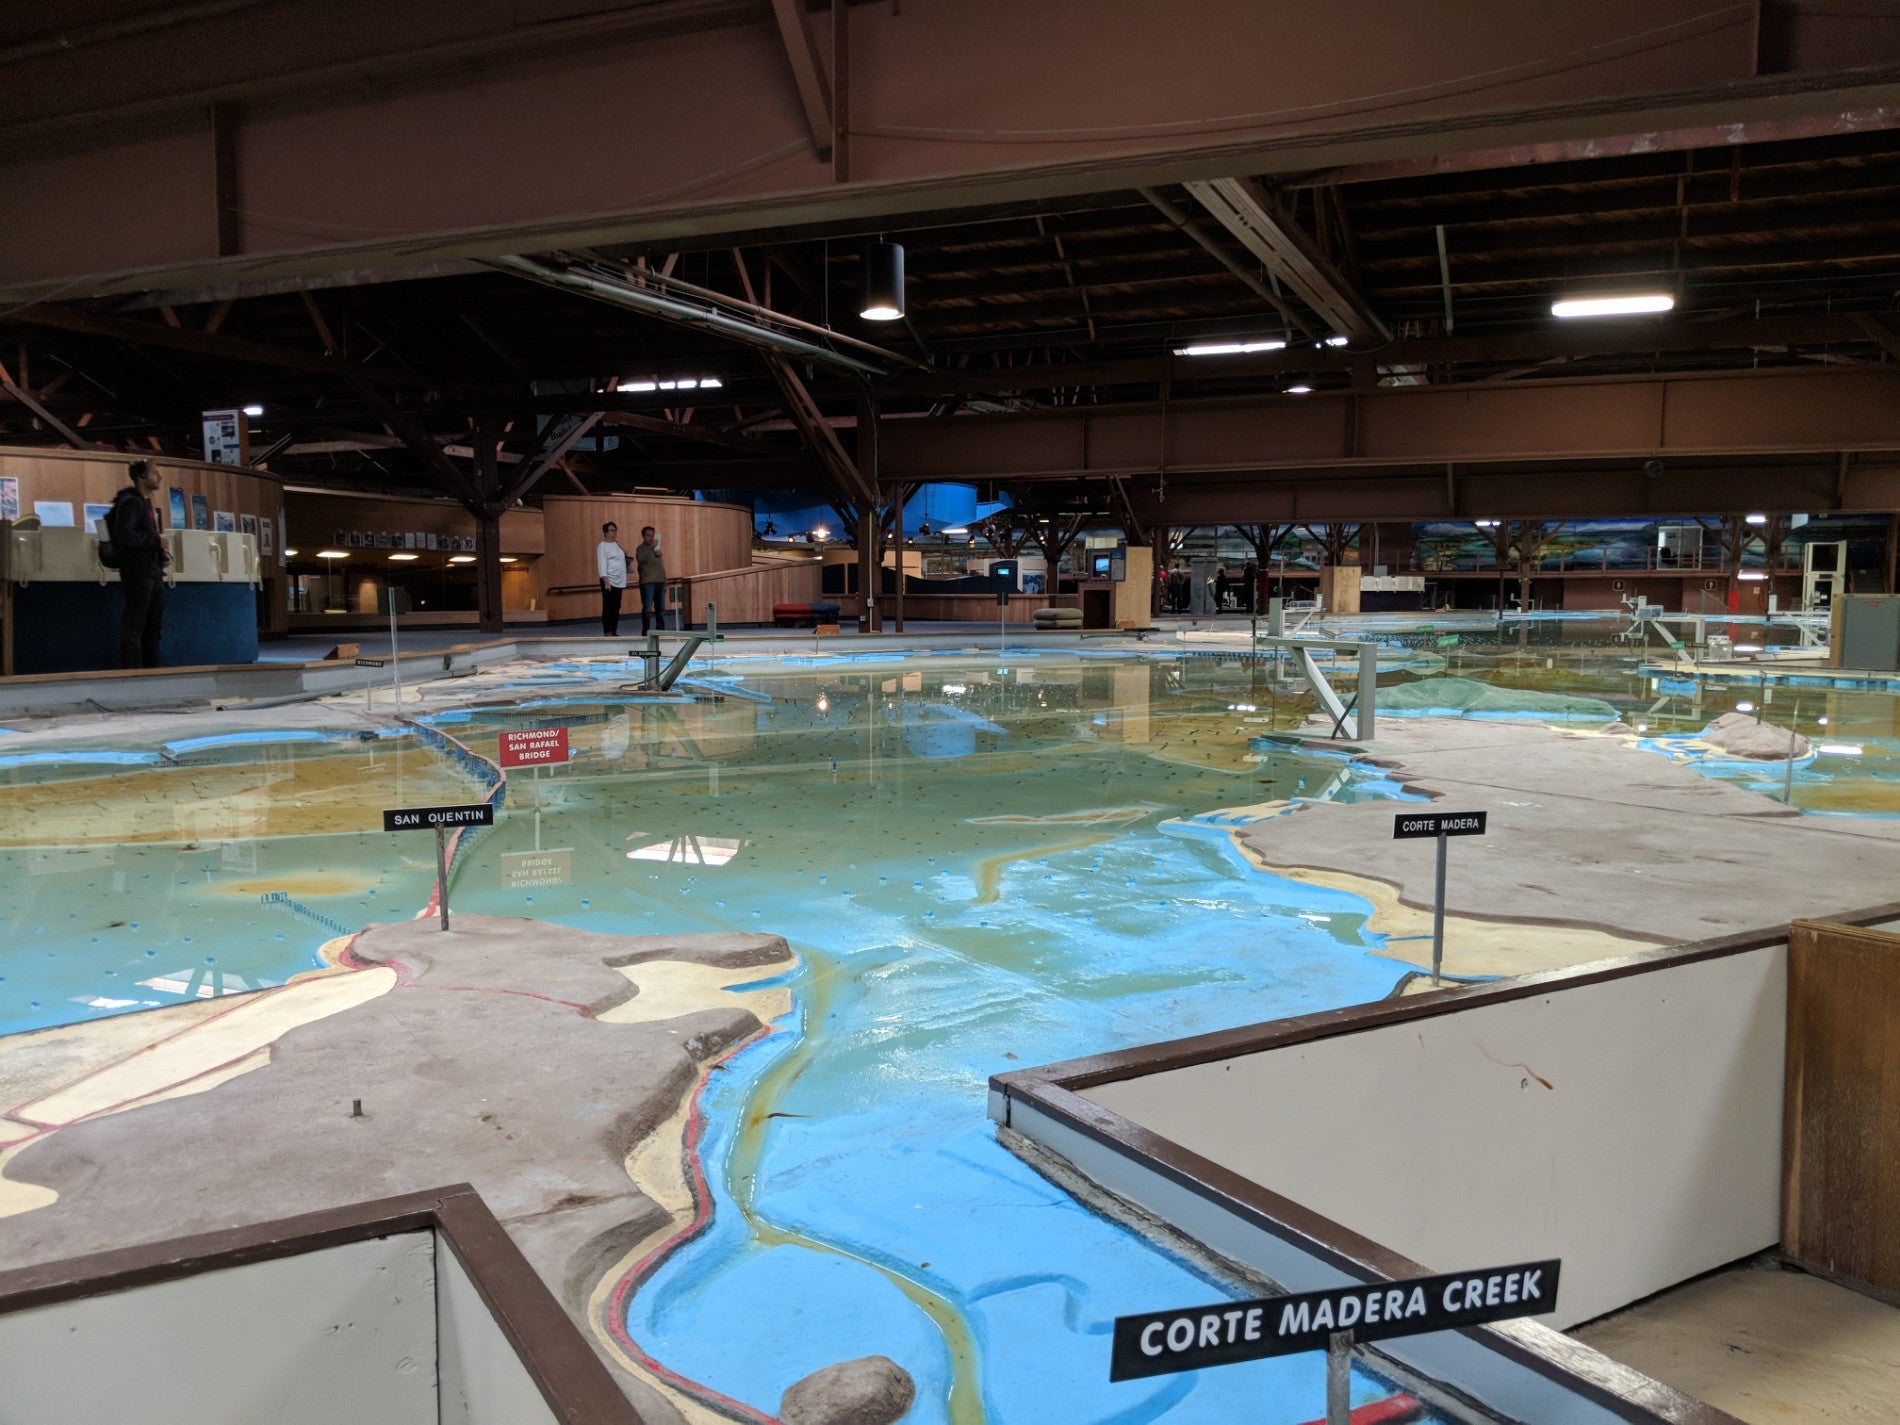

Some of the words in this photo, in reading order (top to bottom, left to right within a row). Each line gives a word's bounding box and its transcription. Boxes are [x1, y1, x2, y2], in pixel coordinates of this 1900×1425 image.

[508, 729, 560, 741] RICHMOND/
[509, 743, 527, 751] SAN
[530, 740, 560, 749] RAFAEL
[519, 750, 550, 760] BRIDGE
[394, 814, 420, 826] SAN
[428, 810, 484, 823] QUENTIN
[1402, 820, 1435, 832] CORTE
[1441, 818, 1479, 830] MADERA
[1140, 1308, 1263, 1356] CORTE
[1278, 1287, 1426, 1336] MADERA
[1442, 1269, 1542, 1313] CREEK
